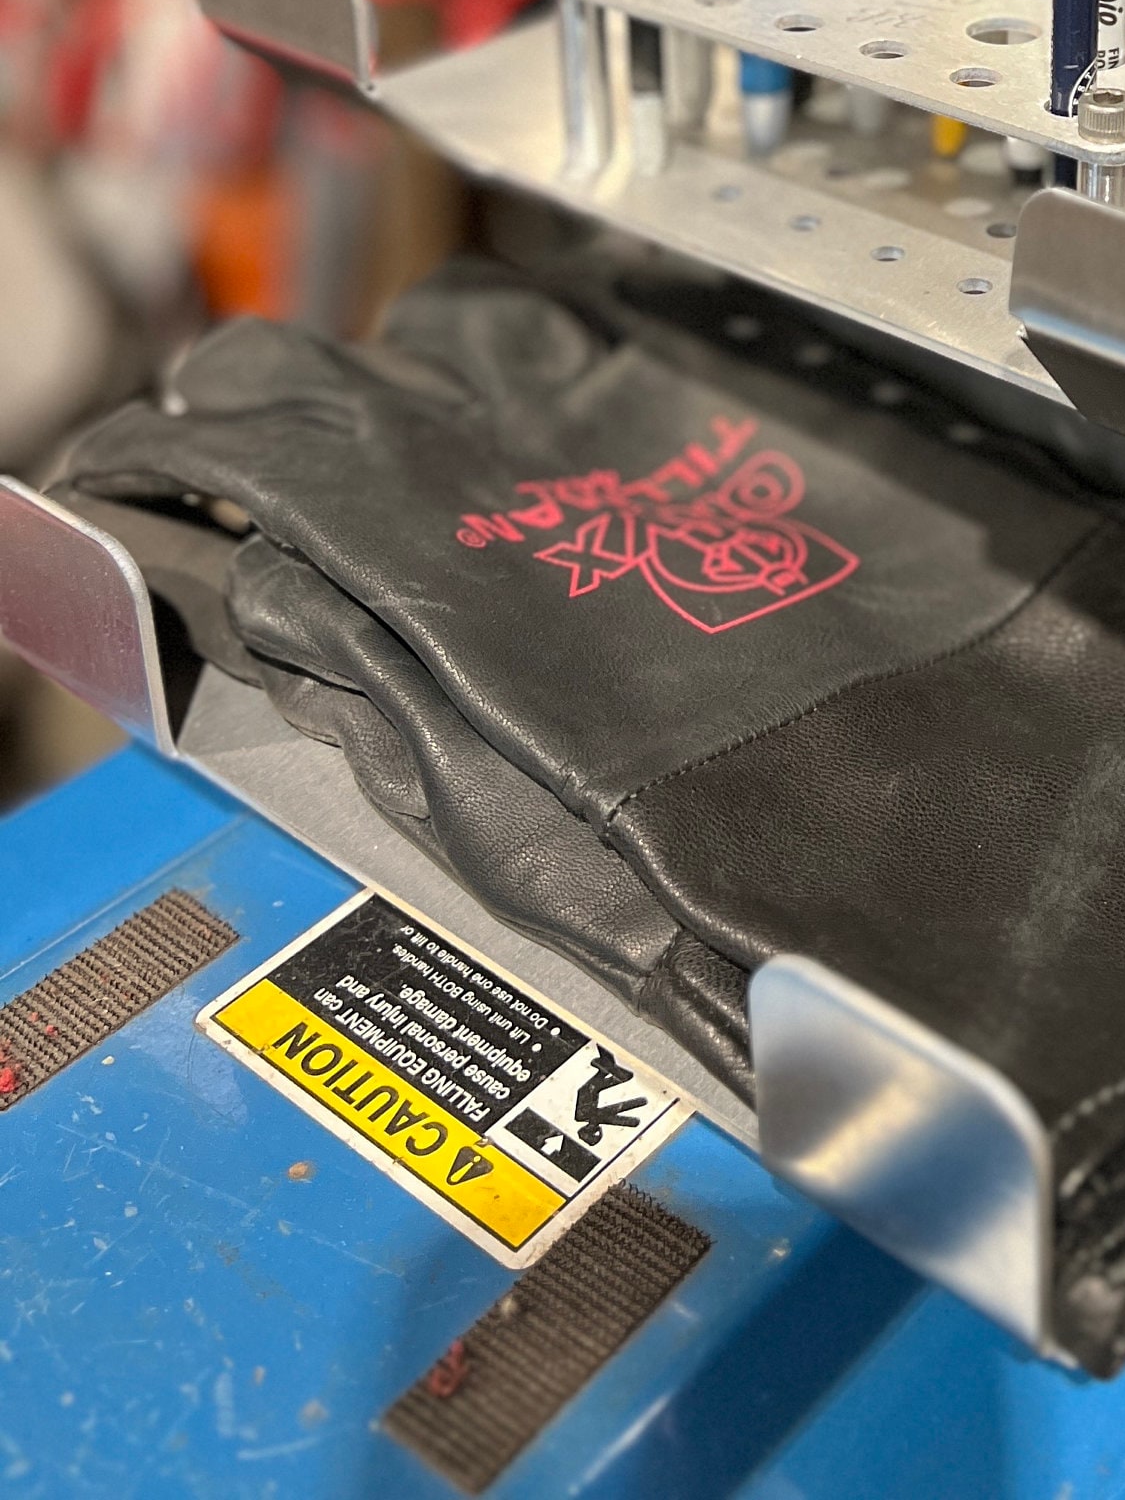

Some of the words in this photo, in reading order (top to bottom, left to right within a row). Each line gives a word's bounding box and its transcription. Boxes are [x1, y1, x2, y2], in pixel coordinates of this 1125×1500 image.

[400, 924, 415, 936] or
[409, 930, 429, 947] lift
[392, 942, 434, 976] handles.
[426, 940, 441, 955] to
[436, 950, 475, 977] handle
[335, 974, 371, 998] and
[428, 973, 465, 998] BOTH
[471, 972, 494, 990] one
[313, 986, 344, 1011] can
[399, 983, 457, 1030] damage.
[461, 992, 492, 1012] using
[491, 986, 514, 1004] use
[367, 995, 410, 1033] injury
[488, 1011, 513, 1031] unit
[510, 1000, 529, 1017] not
[529, 1011, 549, 1030] Do
[335, 1007, 428, 1076] EQUIPMENT
[407, 1024, 471, 1070] personal
[509, 1025, 531, 1045] Lift
[452, 1023, 531, 1082] equipment
[271, 1021, 449, 1157] CAUTION
[462, 1063, 511, 1100] cause
[421, 1068, 491, 1122] FALLING
